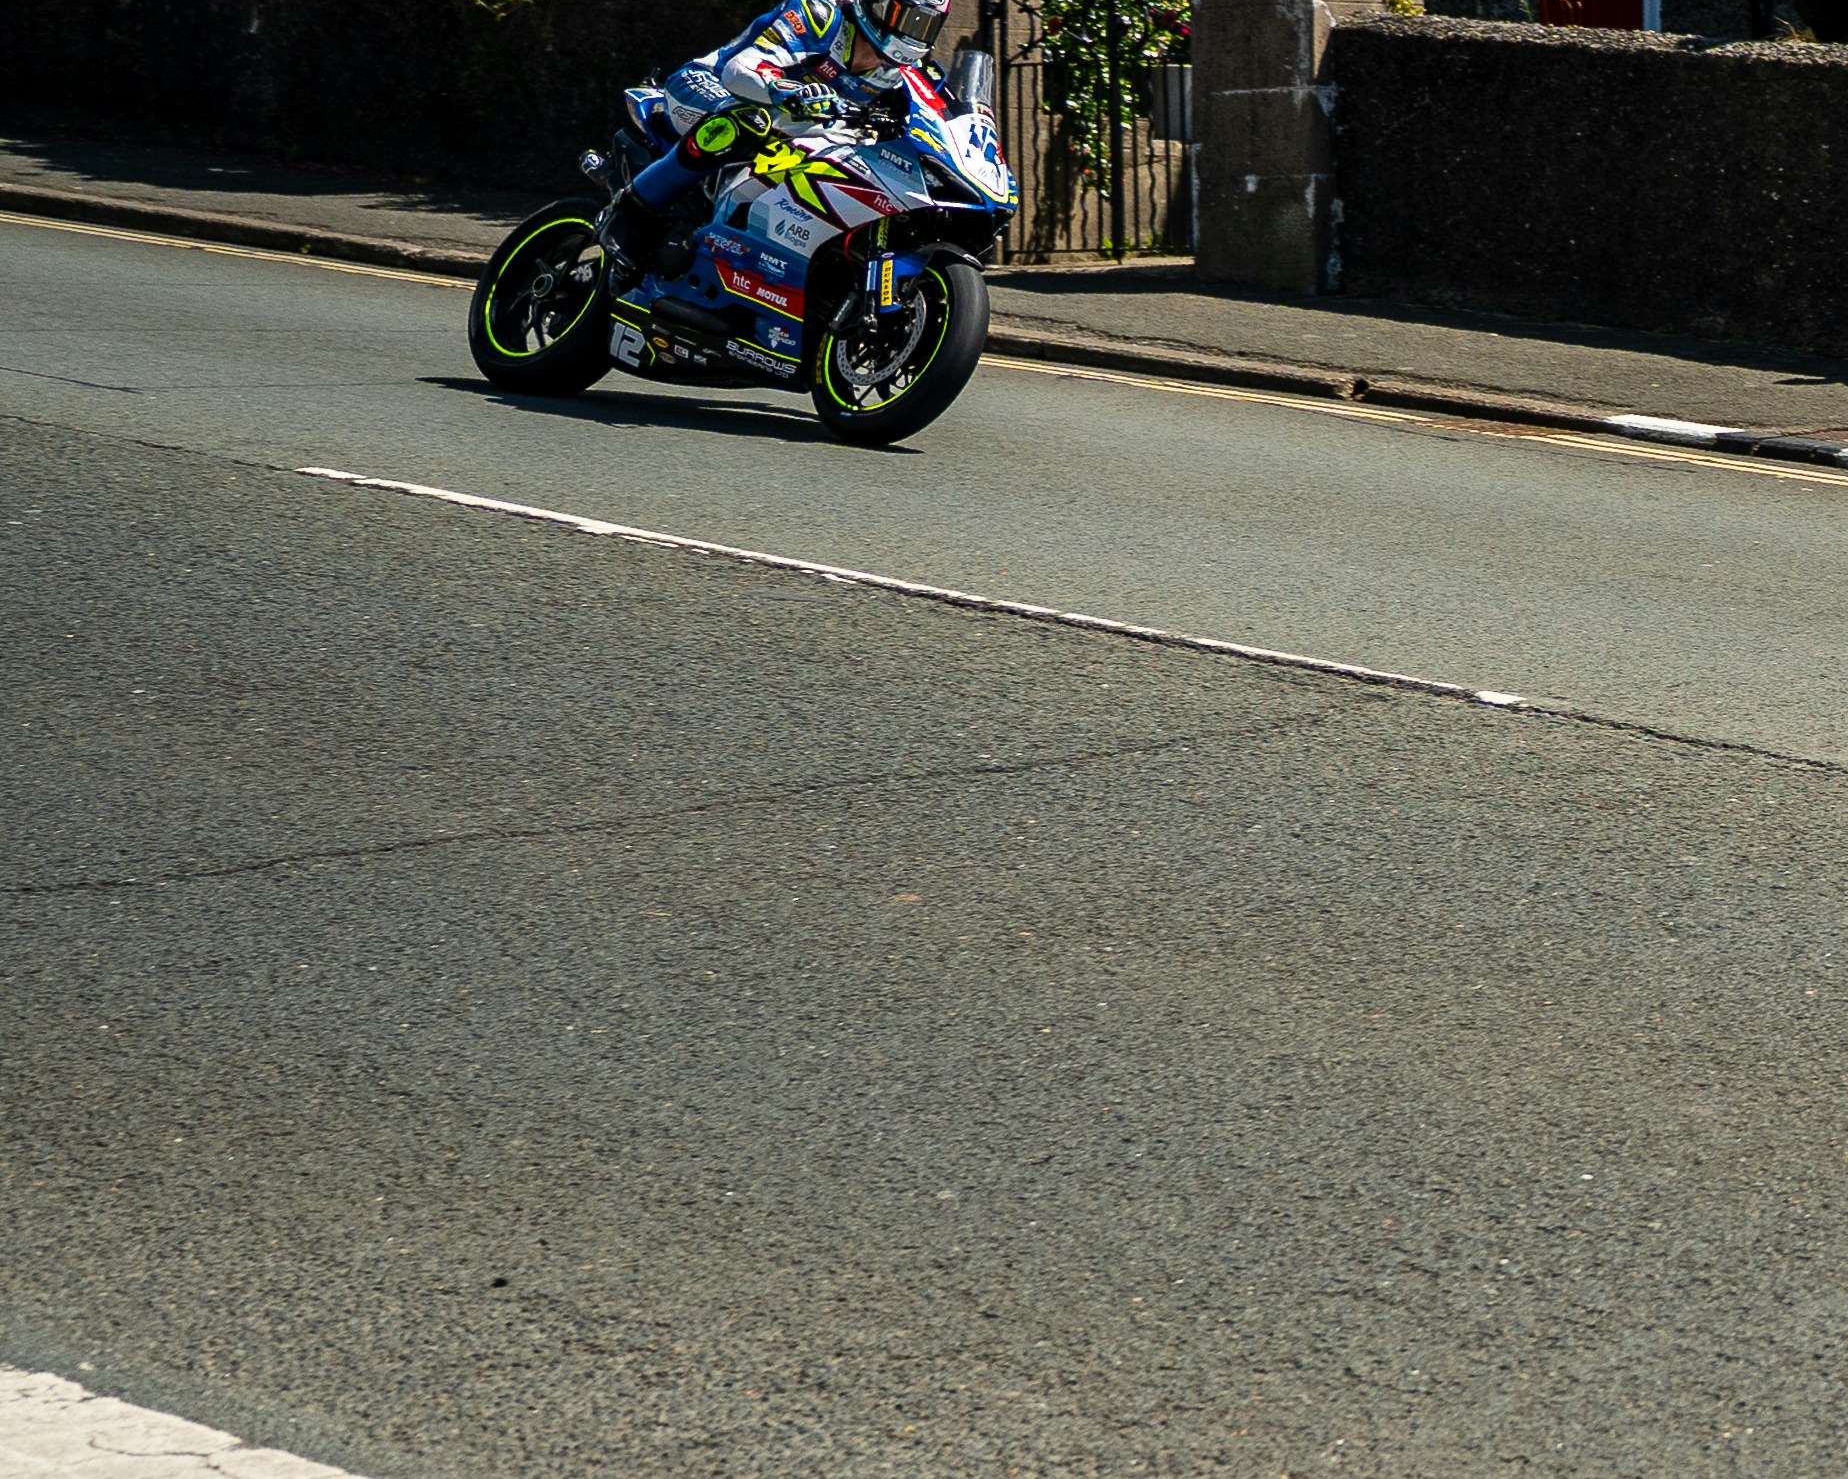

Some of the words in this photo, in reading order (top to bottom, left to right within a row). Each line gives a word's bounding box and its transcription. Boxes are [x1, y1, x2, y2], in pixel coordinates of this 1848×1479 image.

[820, 61, 838, 78] htc
[880, 148, 913, 170] NMT
[776, 198, 814, 222] Racing
[874, 195, 893, 212] htc
[788, 223, 810, 241] ARB
[760, 252, 788, 269] NMT
[733, 272, 751, 290] htc
[756, 287, 788, 307] MOTUL
[610, 321, 646, 368] 12
[726, 340, 797, 374] BURROWS
